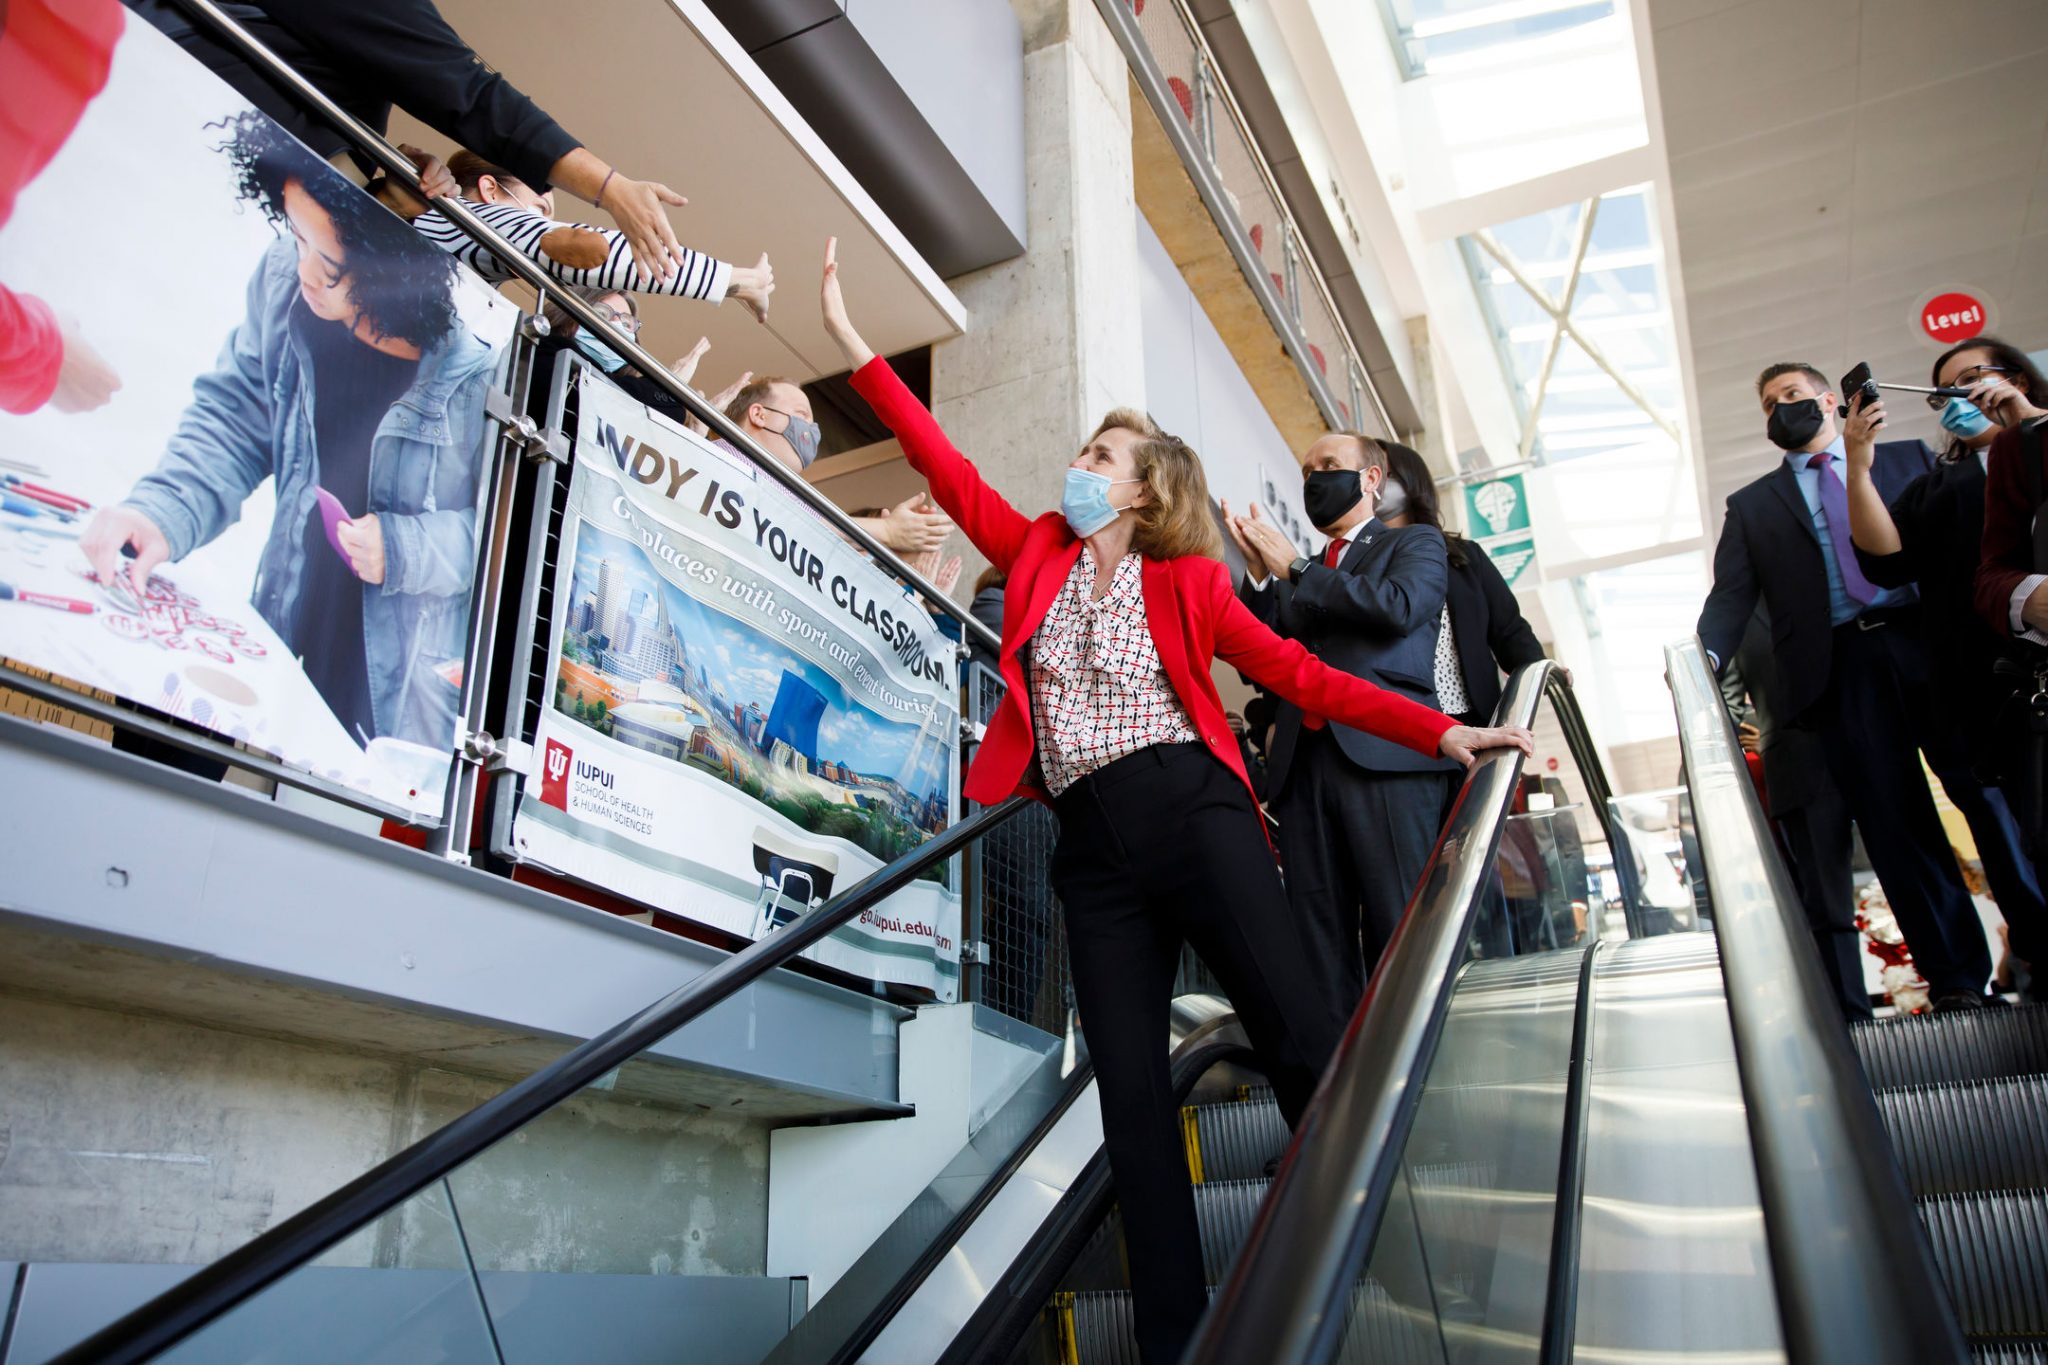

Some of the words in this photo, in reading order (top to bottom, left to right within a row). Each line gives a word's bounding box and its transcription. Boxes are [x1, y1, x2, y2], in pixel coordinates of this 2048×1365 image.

[1926, 305, 1981, 331] Level
[699, 479, 745, 529] IS
[753, 507, 824, 594] YOUR
[831, 575, 950, 691] CLASSROOM.
[721, 576, 777, 617] with
[778, 608, 830, 650] sport
[829, 641, 862, 673] and
[853, 666, 881, 696] event
[576, 760, 614, 790] IUPUI
[572, 796, 578, 807] &
[580, 798, 612, 819] HUMAN
[613, 811, 653, 835] SCIENCES
[574, 780, 609, 803] SCHOOL
[609, 795, 620, 807] OF
[620, 799, 654, 820] HEALTH
